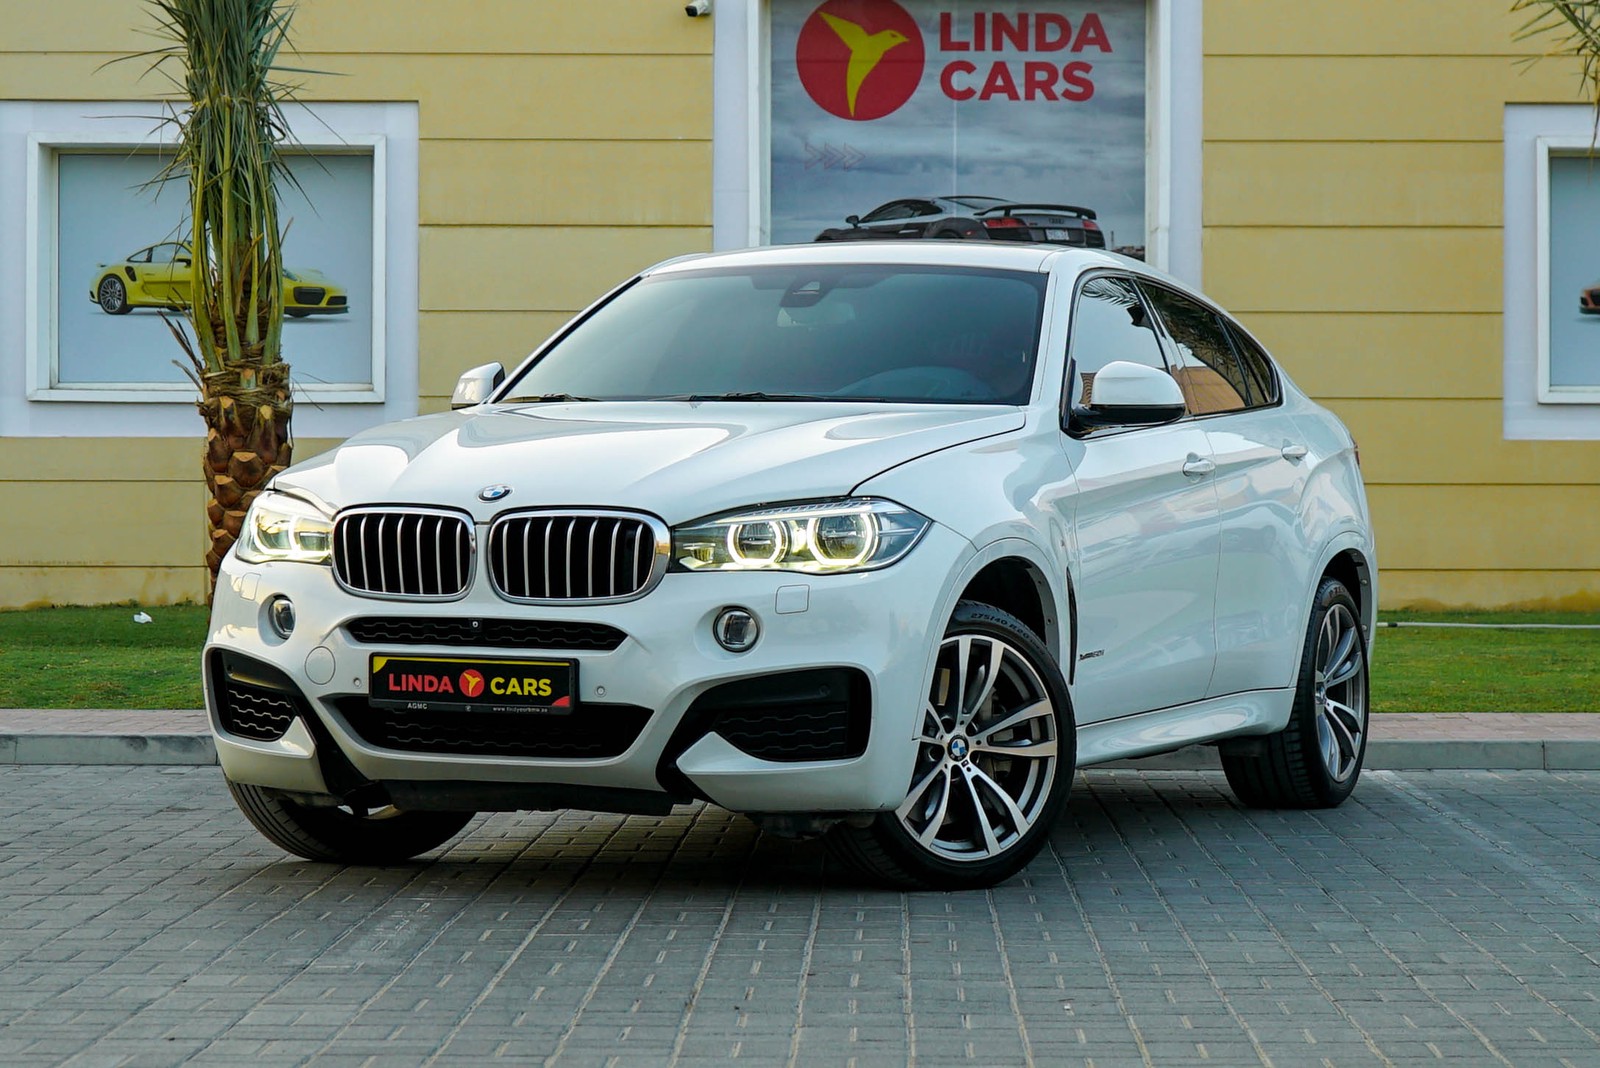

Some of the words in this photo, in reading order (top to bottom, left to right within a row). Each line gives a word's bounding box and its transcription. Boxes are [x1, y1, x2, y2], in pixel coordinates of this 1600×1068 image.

[940, 12, 1112, 53] LINDA
[940, 60, 1095, 101] CARS
[389, 673, 454, 693] LINDA
[490, 677, 552, 696] CARS
